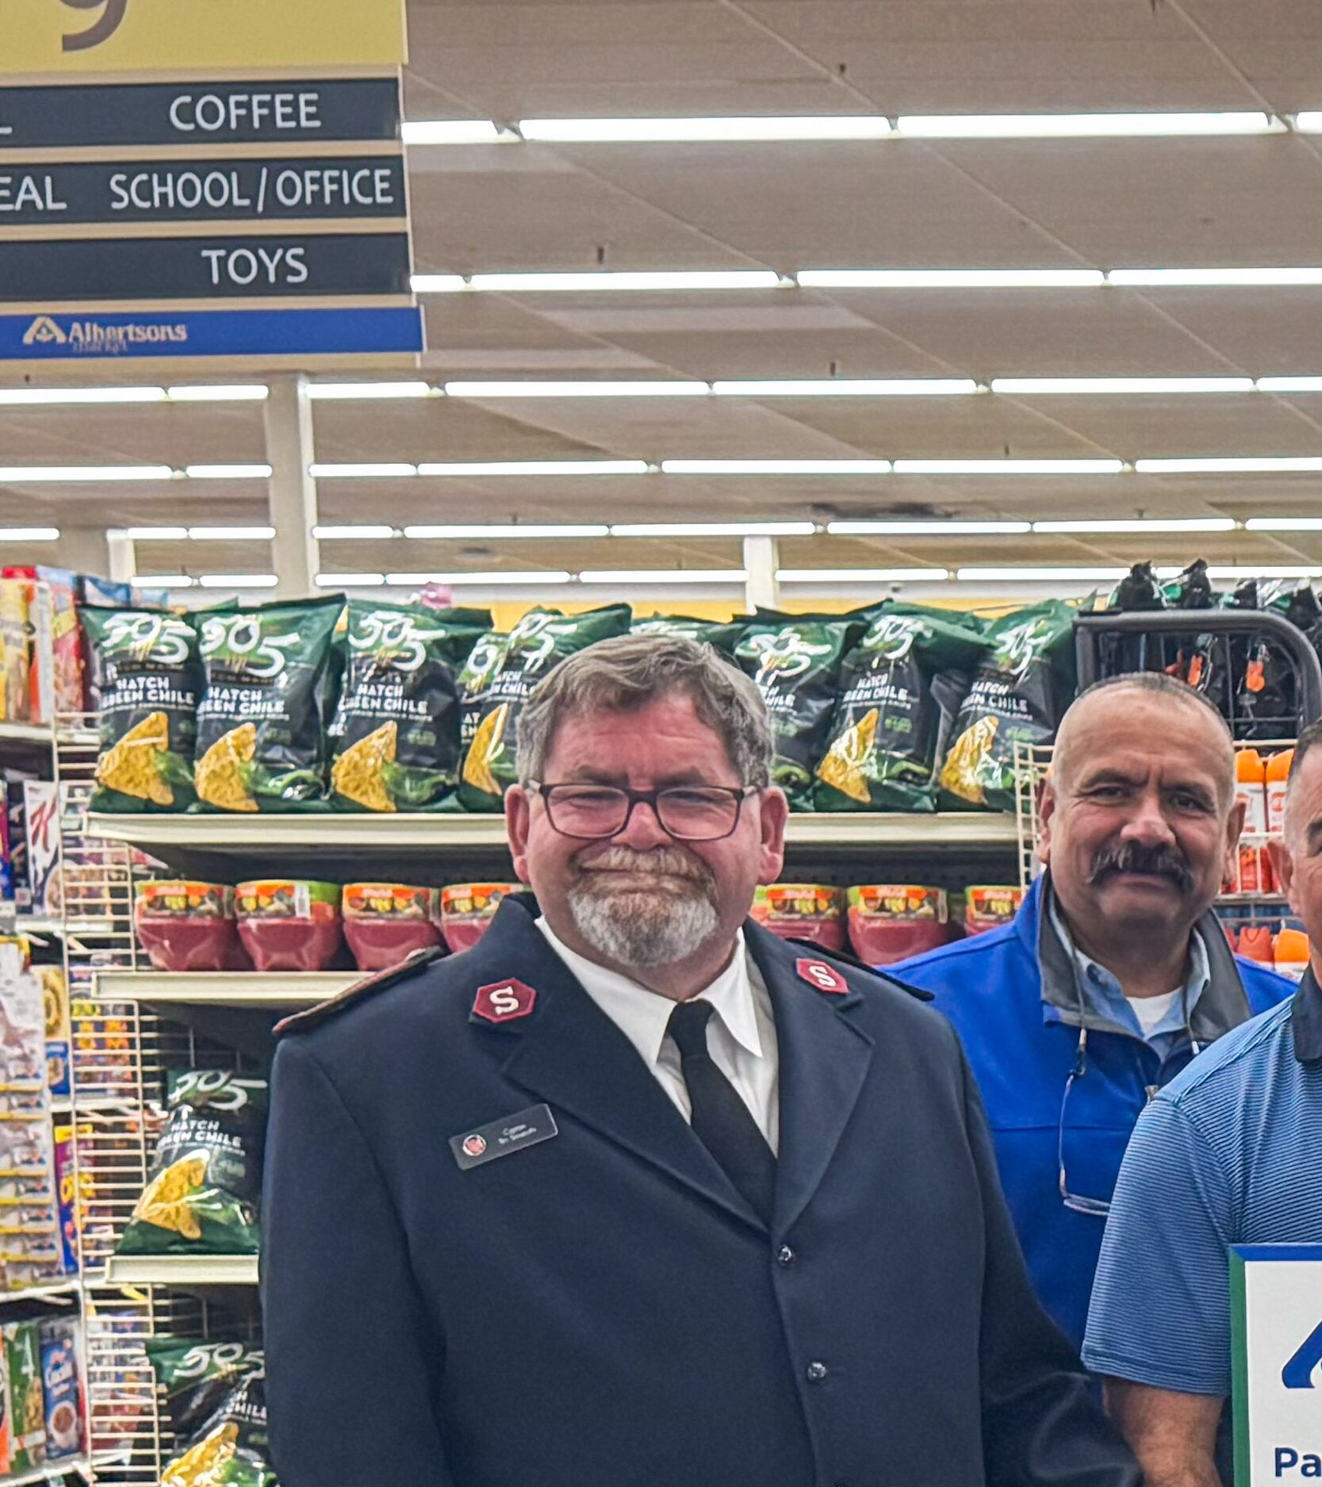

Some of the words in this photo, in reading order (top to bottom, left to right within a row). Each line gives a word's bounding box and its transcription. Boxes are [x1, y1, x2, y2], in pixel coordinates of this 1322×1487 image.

[170, 93, 321, 131] COFFEE
[201, 247, 308, 285] TOYS
[68, 321, 188, 344] Albertsons
[146, 688, 195, 705] CHILE
[208, 687, 263, 702] HATCH
[239, 700, 286, 715] CHILE
[383, 698, 429, 715] CHILE
[809, 964, 837, 989] S
[489, 986, 519, 1015] S
[195, 1130, 242, 1148] CHILE
